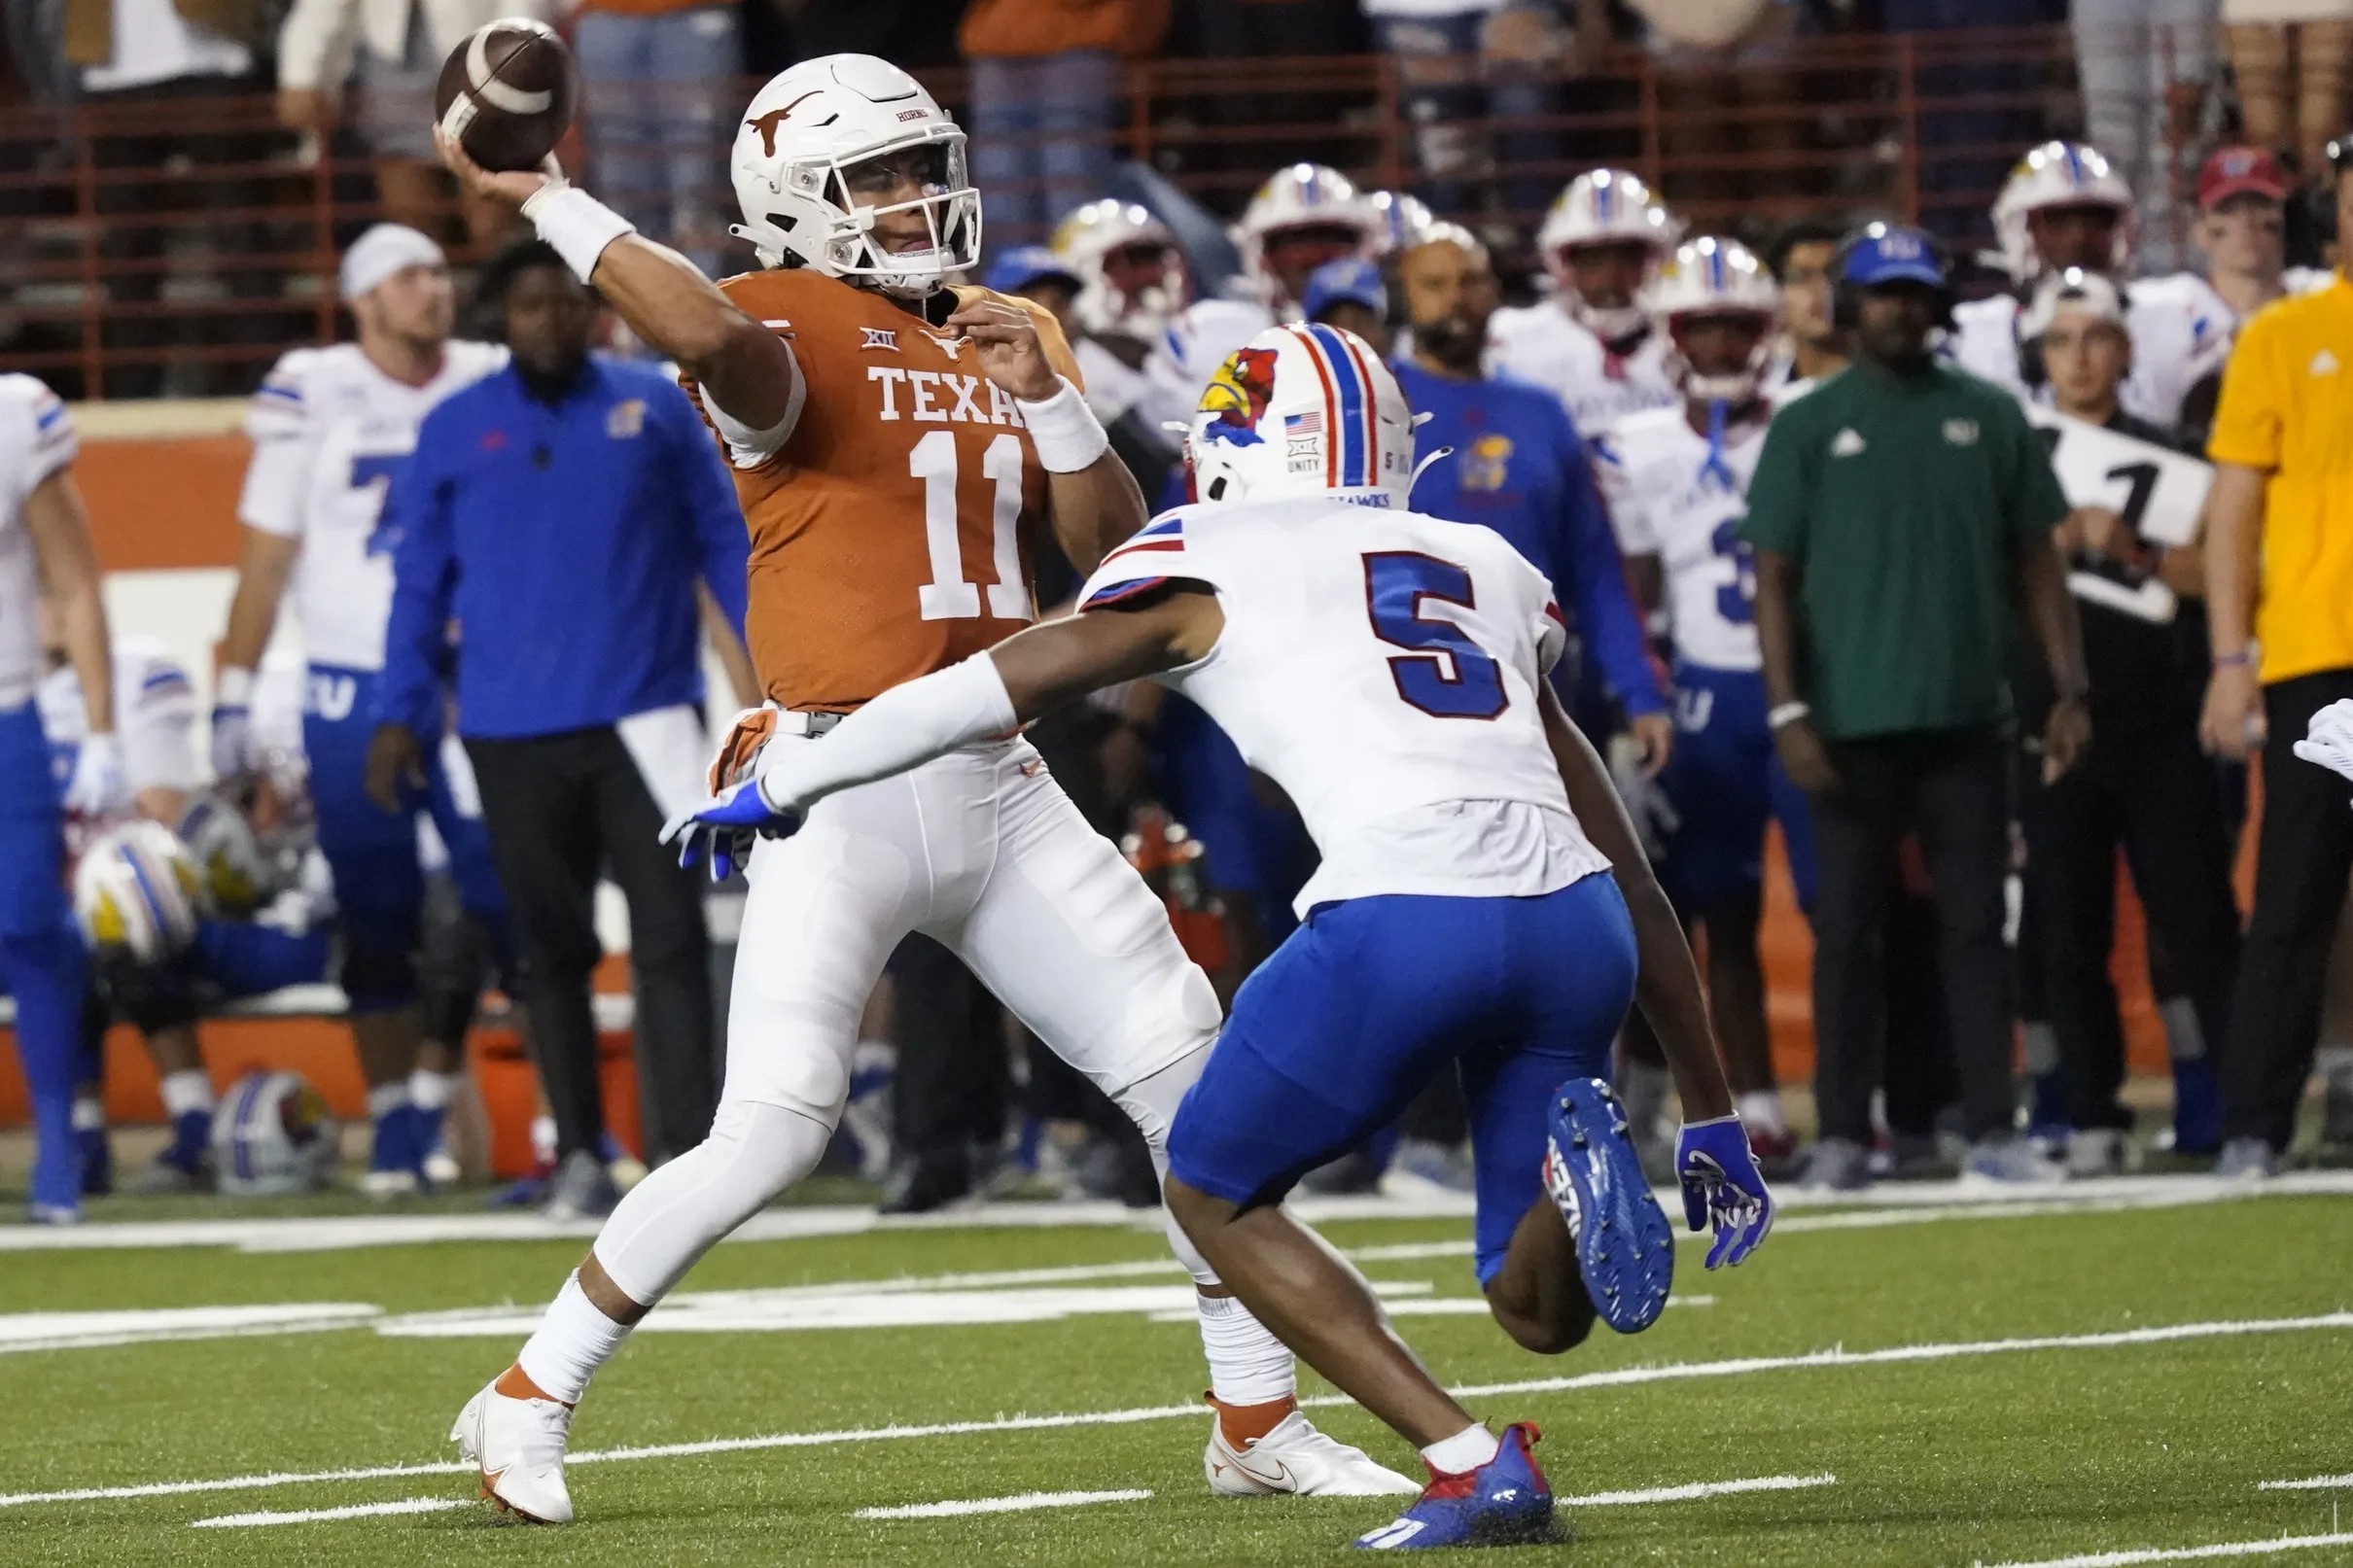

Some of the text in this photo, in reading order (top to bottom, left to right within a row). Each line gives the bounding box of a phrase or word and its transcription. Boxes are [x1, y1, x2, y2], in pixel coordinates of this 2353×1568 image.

[896, 108, 930, 123] HORNS
[867, 366, 1024, 429] TEXA
[1287, 458, 1319, 473] UNITY
[909, 431, 1033, 622] 11
[1360, 550, 1511, 722] 5
